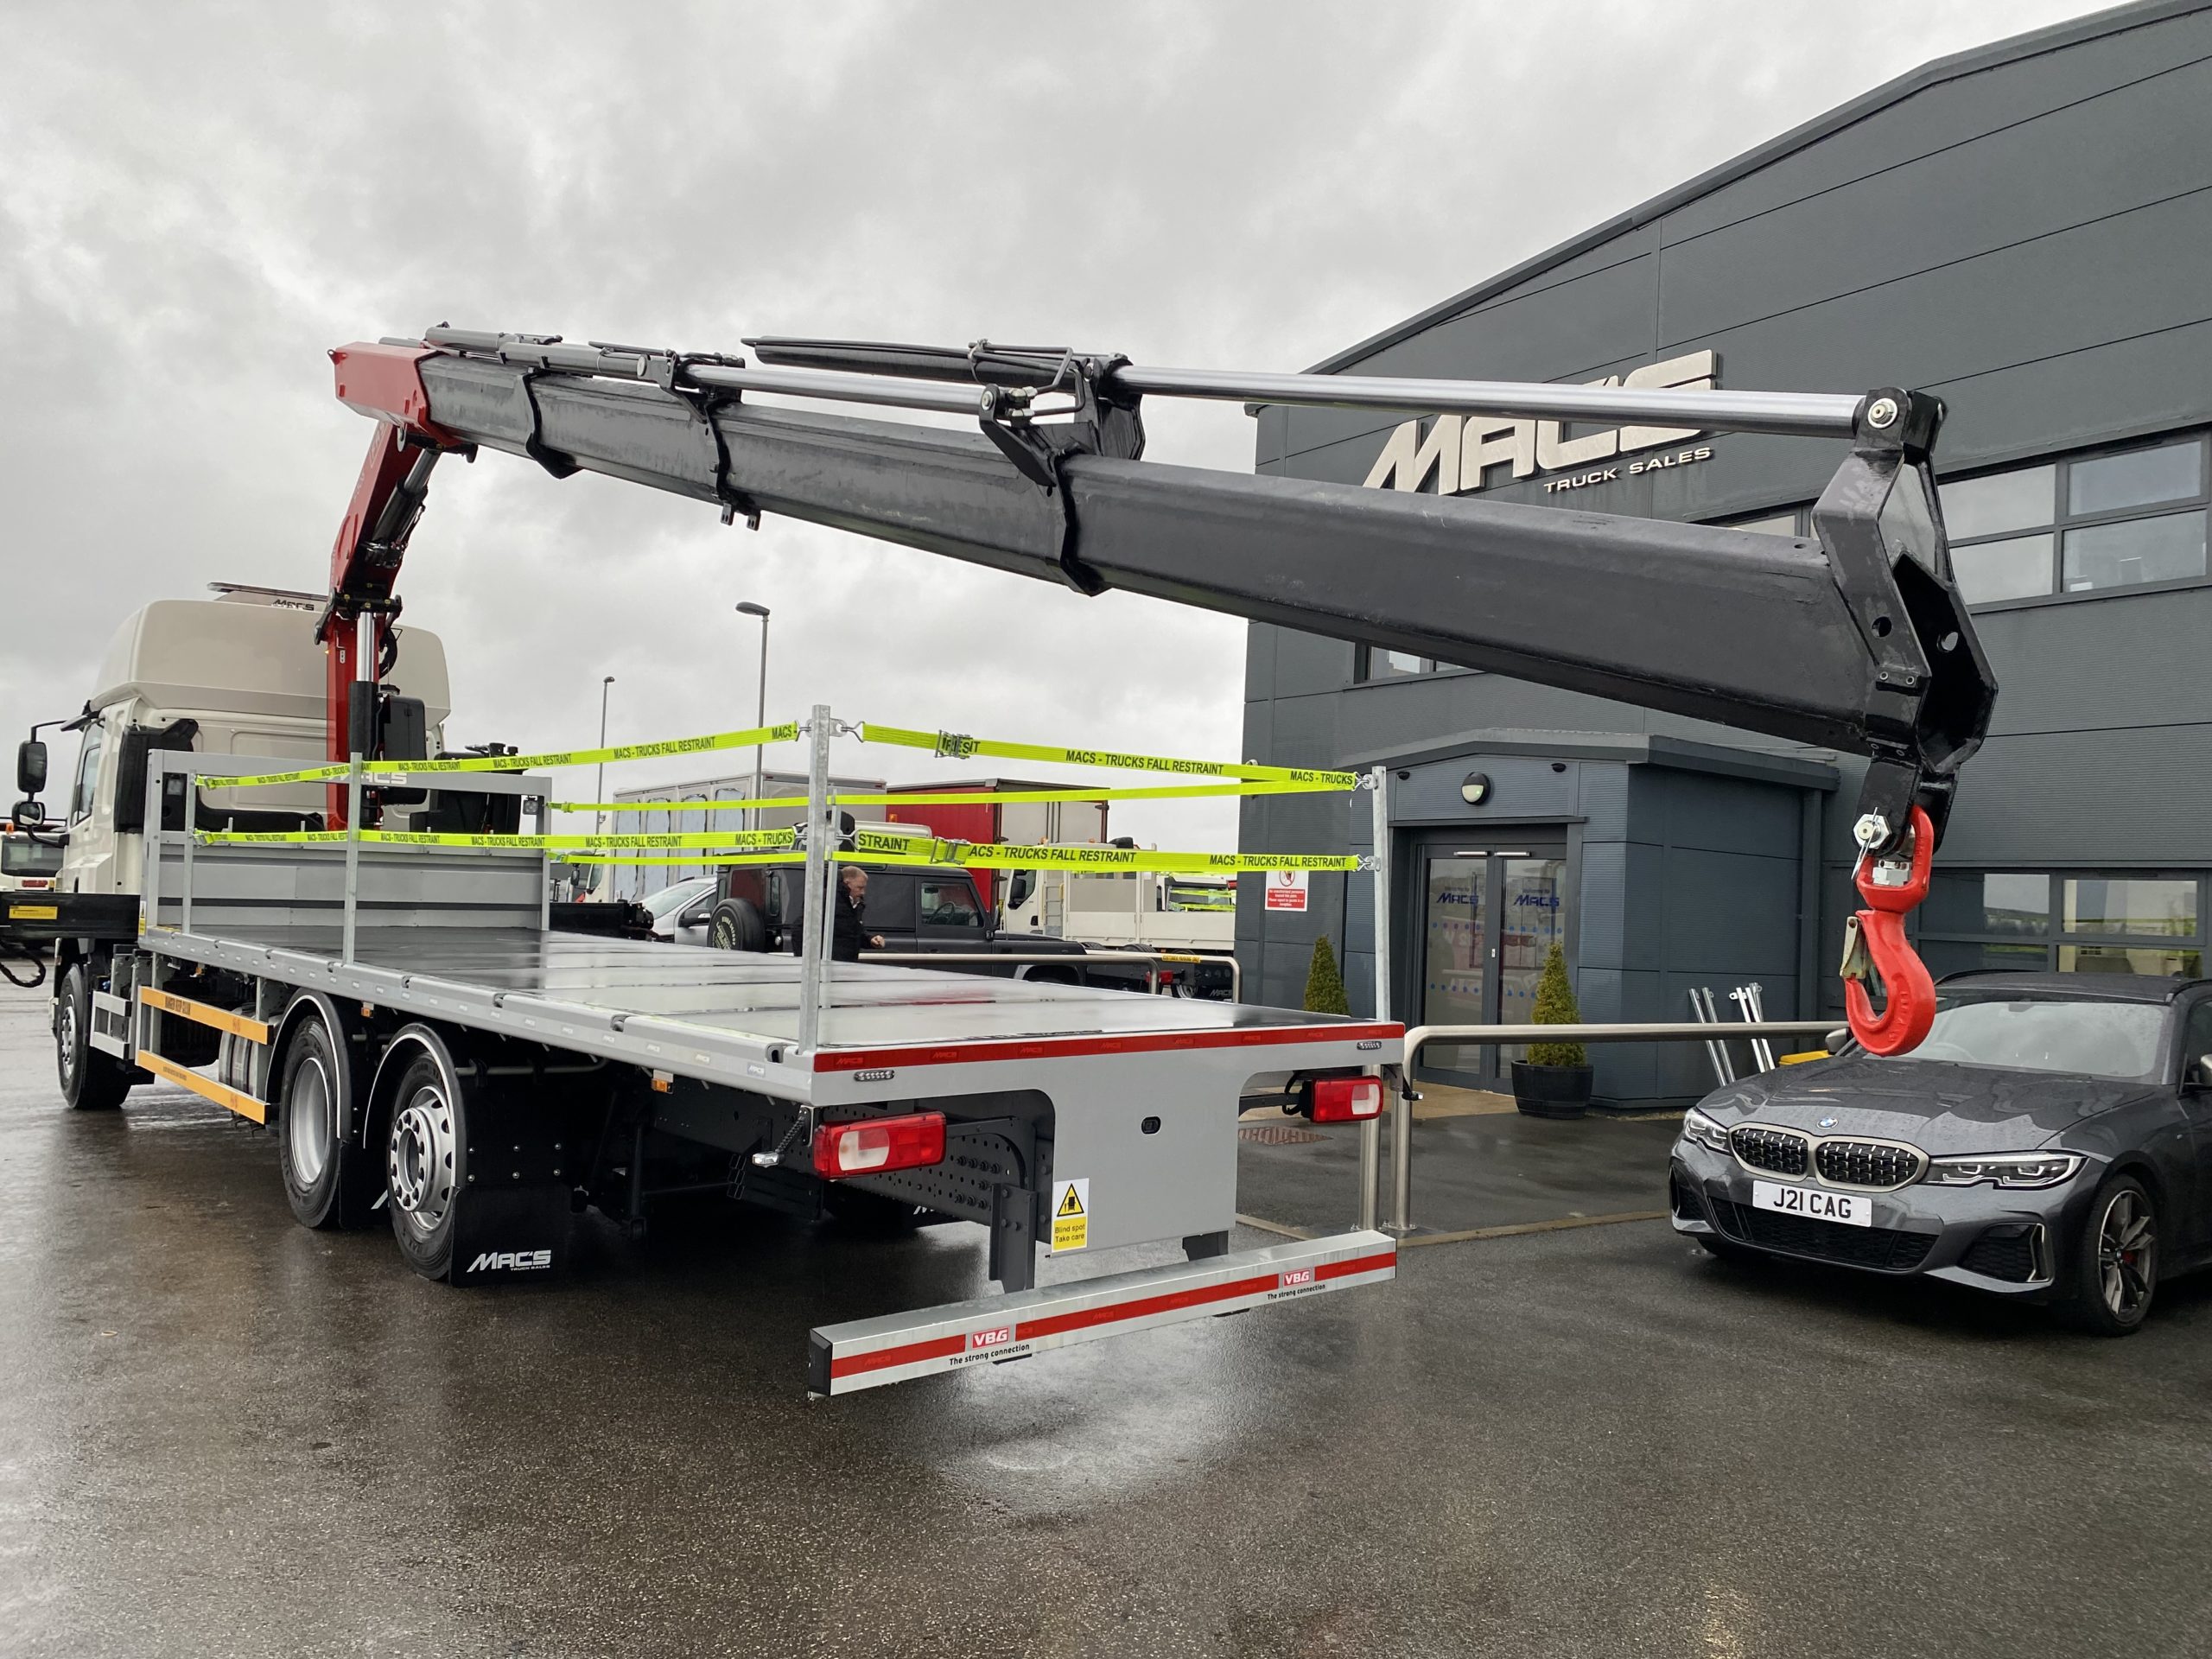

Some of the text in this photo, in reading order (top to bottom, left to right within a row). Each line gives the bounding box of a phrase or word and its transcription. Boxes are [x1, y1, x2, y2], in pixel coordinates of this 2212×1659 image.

[1543, 447, 1712, 493] TRUCK SALES
[493, 759, 507, 768] MACS
[510, 758, 529, 767] TRUCKS
[531, 756, 543, 766] FALL
[543, 753, 572, 765] RESTRAINT
[613, 747, 631, 759] MACS
[636, 744, 660, 757] TRUCKS
[662, 741, 677, 753] FALL
[679, 736, 715, 752] RESTRAINT
[772, 725, 791, 740] MACS
[1066, 750, 1096, 764] MACS
[1106, 753, 1144, 768] TRUCKS
[1147, 759, 1170, 771] FALL
[1173, 760, 1224, 774] RESTRAINT
[1291, 771, 1313, 782] MACS
[1320, 773, 1353, 785] TRUCKS
[471, 836, 484, 845] MACS
[487, 836, 505, 847] TRUCKS
[506, 836, 518, 847] FALL
[518, 837, 545, 847] RESTRAINT
[586, 836, 601, 847] MACS
[606, 836, 629, 847] TRUCKS
[631, 836, 646, 847] FALL
[646, 836, 683, 847] RESTRAINT
[735, 833, 756, 845] MACS
[762, 831, 793, 845] TRUCKS
[968, 845, 994, 857] ACS
[1004, 847, 1048, 860] TRUCKS
[1051, 849, 1077, 861] FALL
[1078, 850, 1137, 862] RESTRAINT
[1210, 855, 1236, 865] MACS
[1243, 855, 1278, 866] TRUCKS
[1281, 856, 1300, 867] FALL
[1301, 857, 1346, 868] RESTRAINT
[1773, 1188, 1851, 1218] J21 CAG
[1071, 1224, 1085, 1232] spot
[1285, 1271, 1310, 1285] VBG
[1279, 1289, 1296, 1298] strong
[1298, 1284, 1325, 1294] connection
[973, 1329, 1009, 1346] VBG
[964, 1351, 988, 1362] strong
[990, 1344, 1030, 1357] connection
